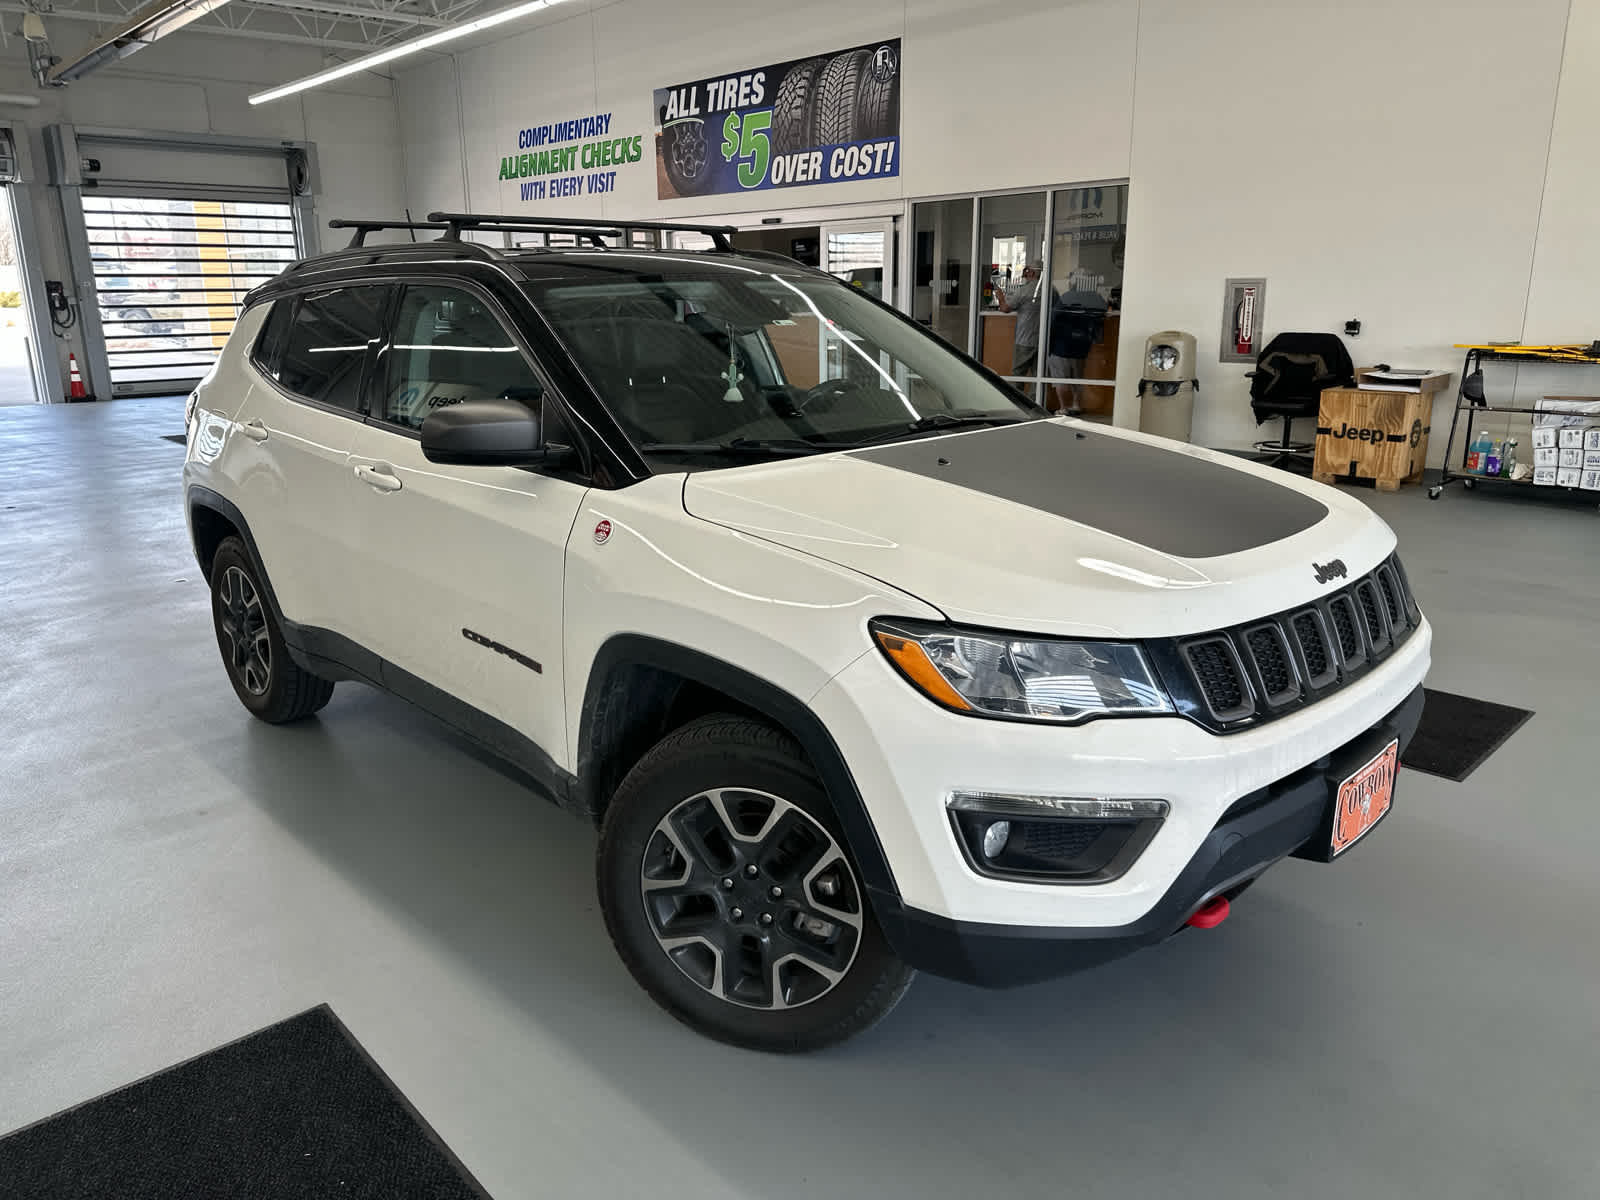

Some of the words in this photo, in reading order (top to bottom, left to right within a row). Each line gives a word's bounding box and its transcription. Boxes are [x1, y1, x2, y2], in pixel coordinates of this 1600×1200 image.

[665, 86, 700, 120] ALL
[706, 72, 766, 112] TIRES
[518, 112, 612, 149] COMPLIMENTARY
[721, 110, 772, 188] $5
[498, 145, 578, 181] ALIGNMENT
[581, 135, 642, 169] CHECKS
[771, 151, 823, 185] OVER
[829, 141, 896, 178] COST!
[520, 181, 546, 201] WITH
[549, 175, 584, 198] EVERY
[587, 171, 617, 194] VISIT
[1333, 423, 1384, 445] Jeep
